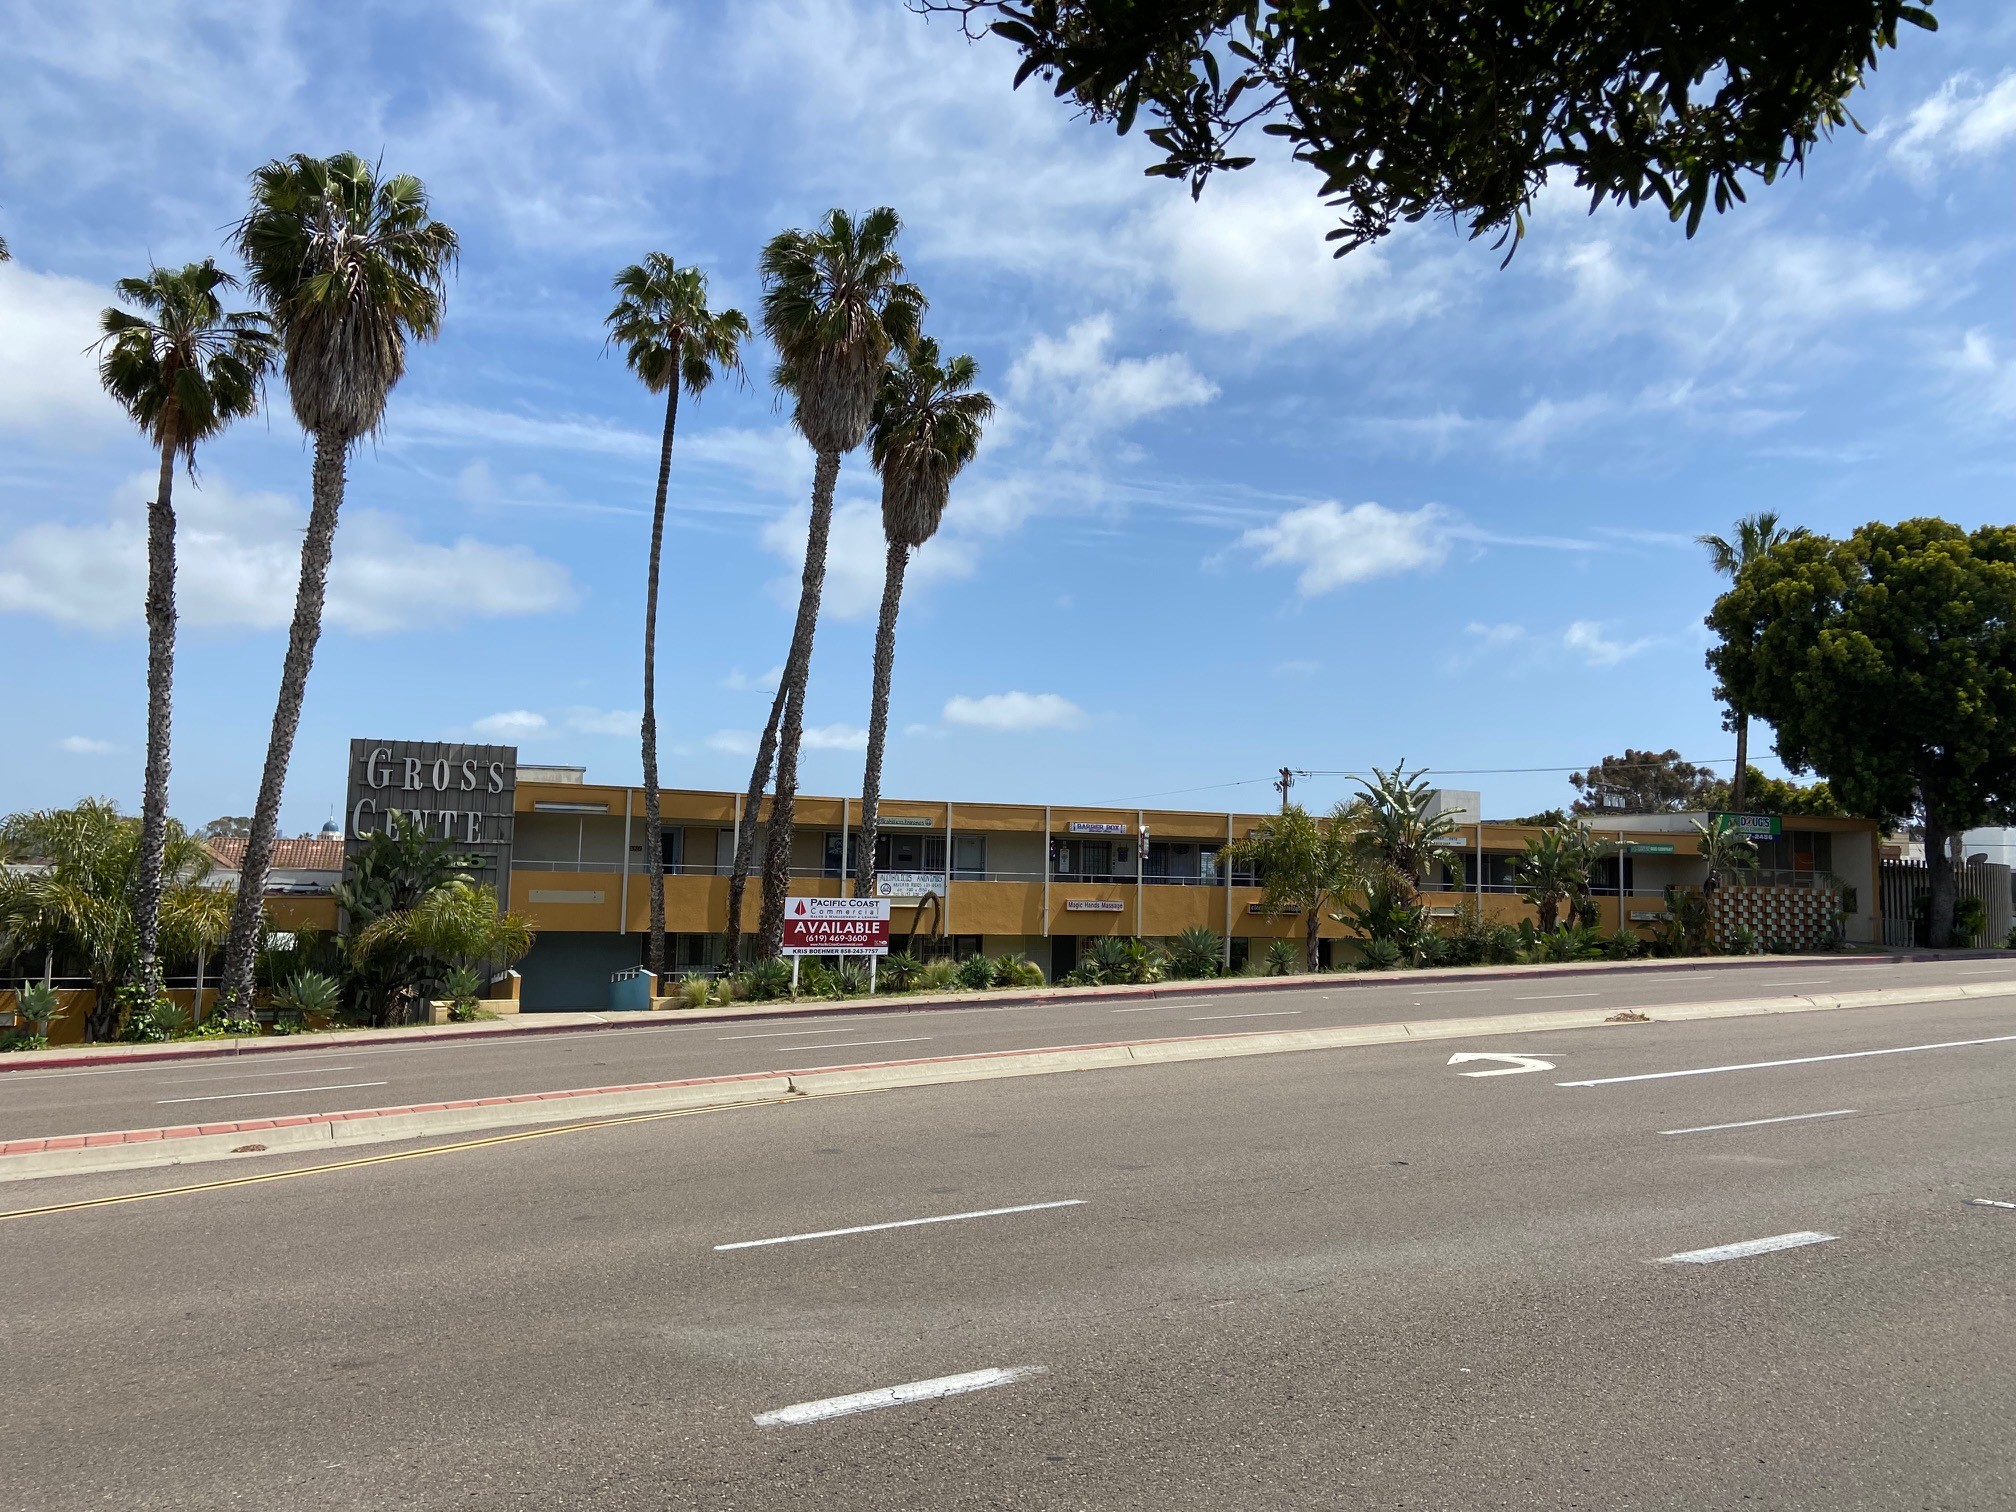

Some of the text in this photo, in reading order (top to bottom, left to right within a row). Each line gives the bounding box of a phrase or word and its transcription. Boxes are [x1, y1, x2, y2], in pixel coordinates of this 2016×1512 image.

[366, 747, 504, 794] GROSS
[1741, 816, 1769, 827] DOUG'S
[1077, 823, 1104, 831] BARBER
[810, 898, 880, 908] PACIFIC COAST
[1068, 901, 1083, 909] Magic
[1101, 902, 1123, 910] Massage
[810, 907, 880, 915] Commercial
[794, 921, 880, 934] AVAILABLE
[805, 934, 868, 943] (619) 469-3600
